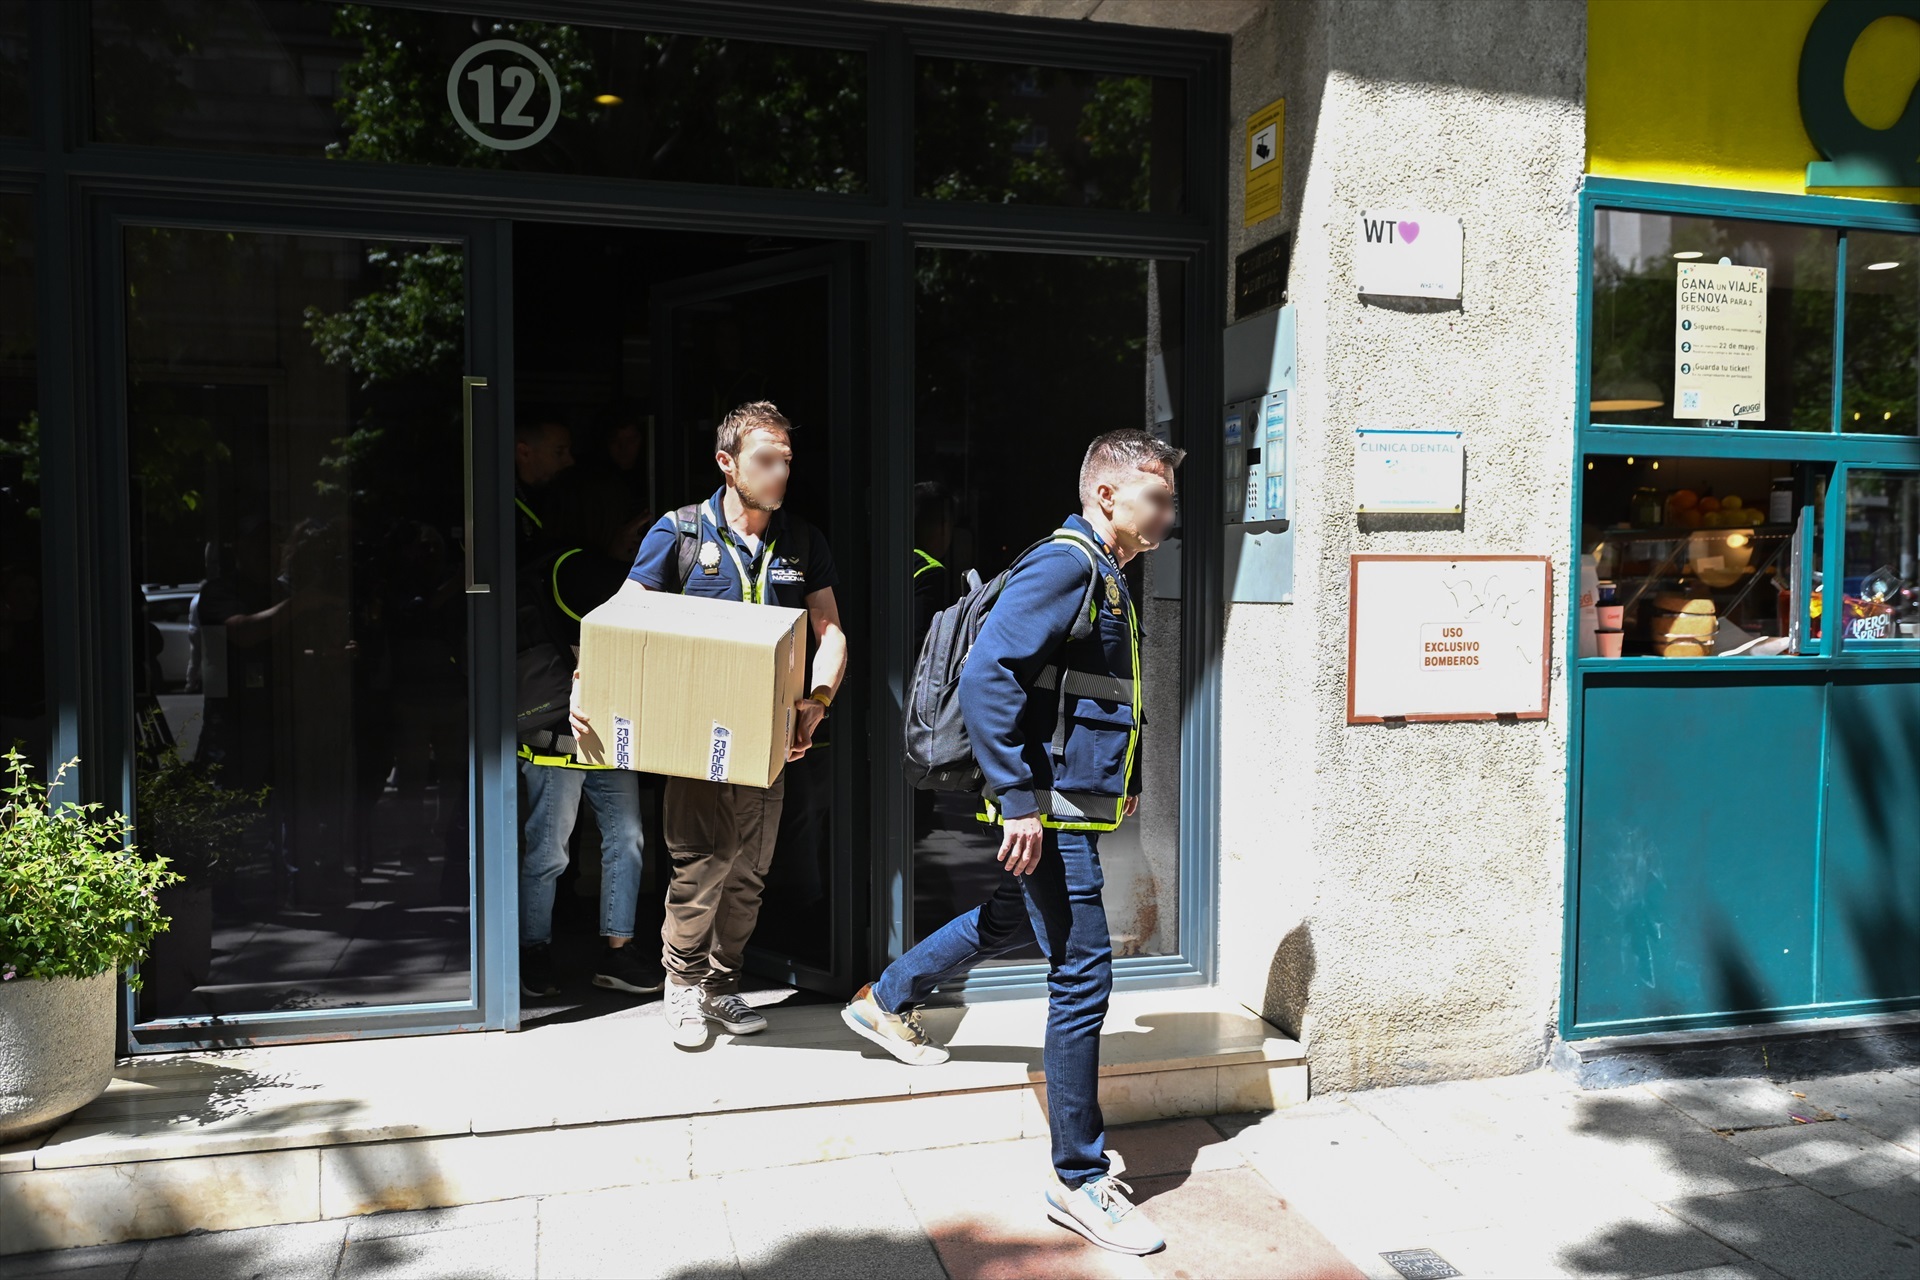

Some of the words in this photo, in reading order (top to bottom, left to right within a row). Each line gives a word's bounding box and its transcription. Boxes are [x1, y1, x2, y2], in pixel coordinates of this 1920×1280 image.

[467, 64, 536, 127] 12
[1363, 218, 1397, 244] WT
[1681, 278, 1715, 291] GANA
[1716, 283, 1727, 291] UN
[1728, 280, 1758, 294] VIAJE
[1730, 298, 1748, 306] PARA
[1681, 304, 1721, 313] PERSONAS
[1682, 342, 1690, 352] 2
[1682, 364, 1690, 374] 3
[1411, 443, 1456, 454] DENTAL
[1844, 613, 1890, 635] APEROL
[1442, 627, 1463, 638] USO
[1424, 641, 1480, 652] EXCLUSIVO
[1424, 655, 1479, 667] BOMBEROS
